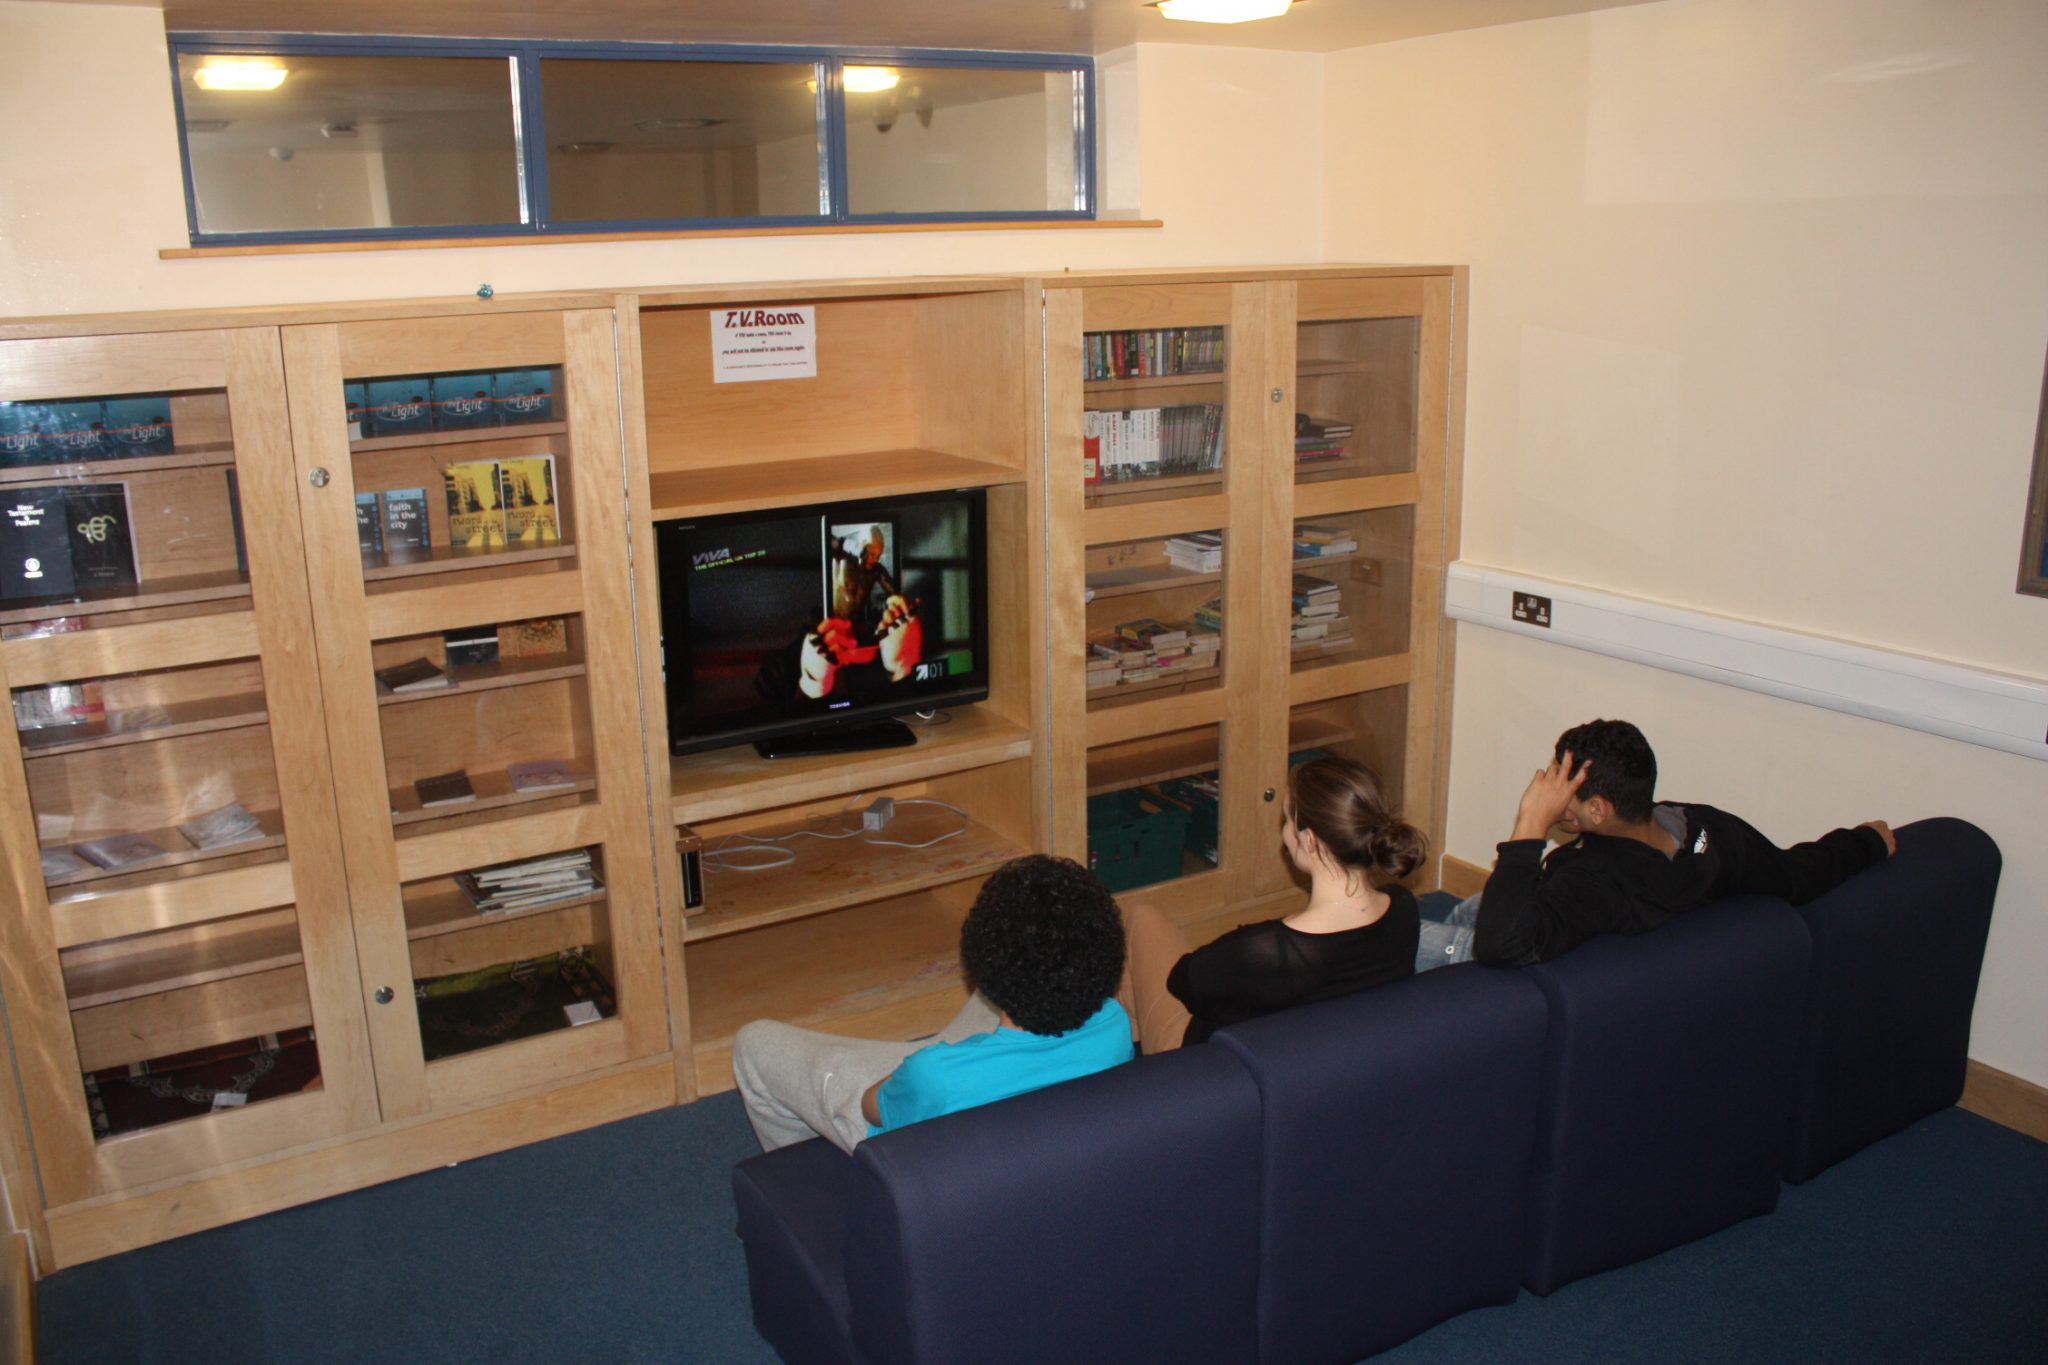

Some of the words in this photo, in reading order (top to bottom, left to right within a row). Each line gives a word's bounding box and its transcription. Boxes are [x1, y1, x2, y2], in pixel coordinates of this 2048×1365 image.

[456, 400, 483, 415] Light
[516, 396, 542, 411] Light
[391, 404, 419, 420] Light
[70, 431, 101, 447] Light
[131, 425, 161, 442] Light
[6, 435, 39, 451] Light
[388, 502, 411, 511] faith
[390, 512, 399, 520] in
[401, 511, 416, 519] the
[519, 518, 556, 528] street
[390, 521, 408, 530] city
[692, 547, 730, 565] VIVA
